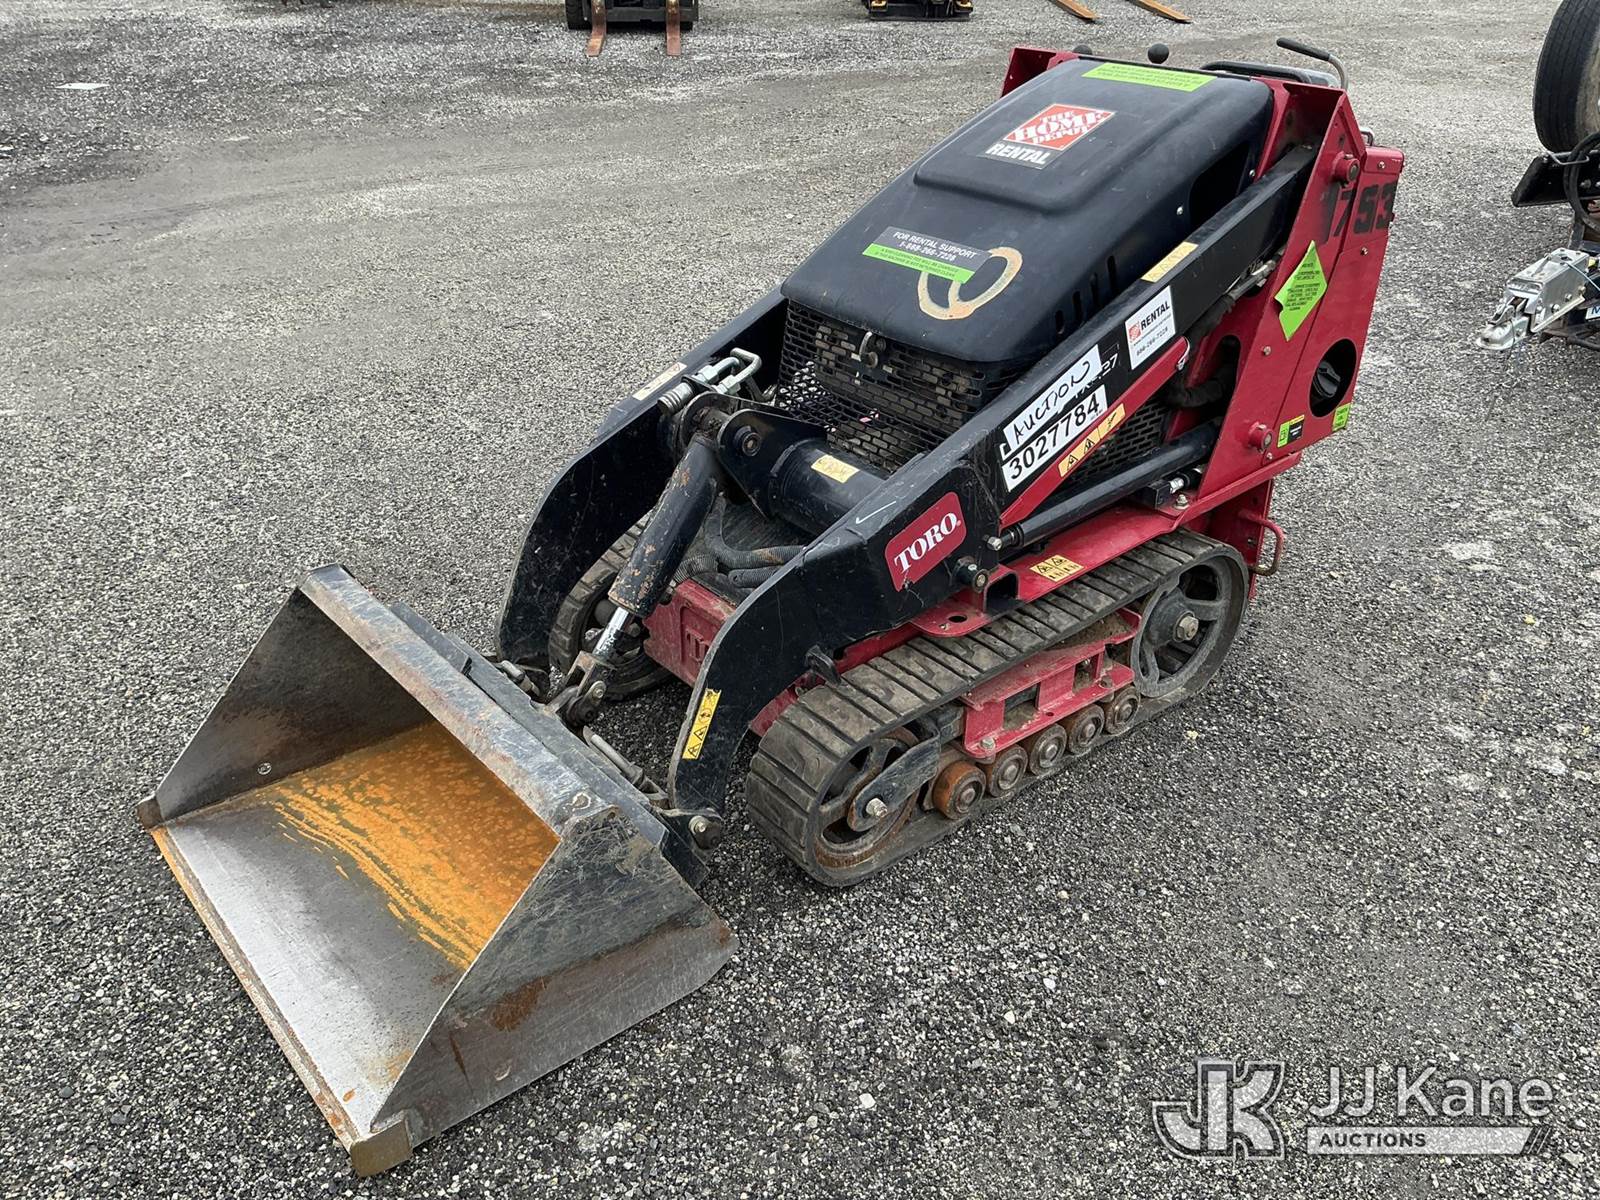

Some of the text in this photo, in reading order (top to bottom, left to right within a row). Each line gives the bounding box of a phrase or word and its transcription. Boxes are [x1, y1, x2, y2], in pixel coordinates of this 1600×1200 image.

[1014, 111, 1104, 141] HOME
[1039, 111, 1074, 123] THE
[1032, 126, 1089, 144] DEPOT
[985, 143, 1051, 164] RENTAL
[893, 231, 978, 259] FOR RENTAL SUPPORT
[1140, 301, 1170, 330] RENTAL
[1009, 392, 1100, 480] 3027784
[893, 512, 958, 575] TORO
